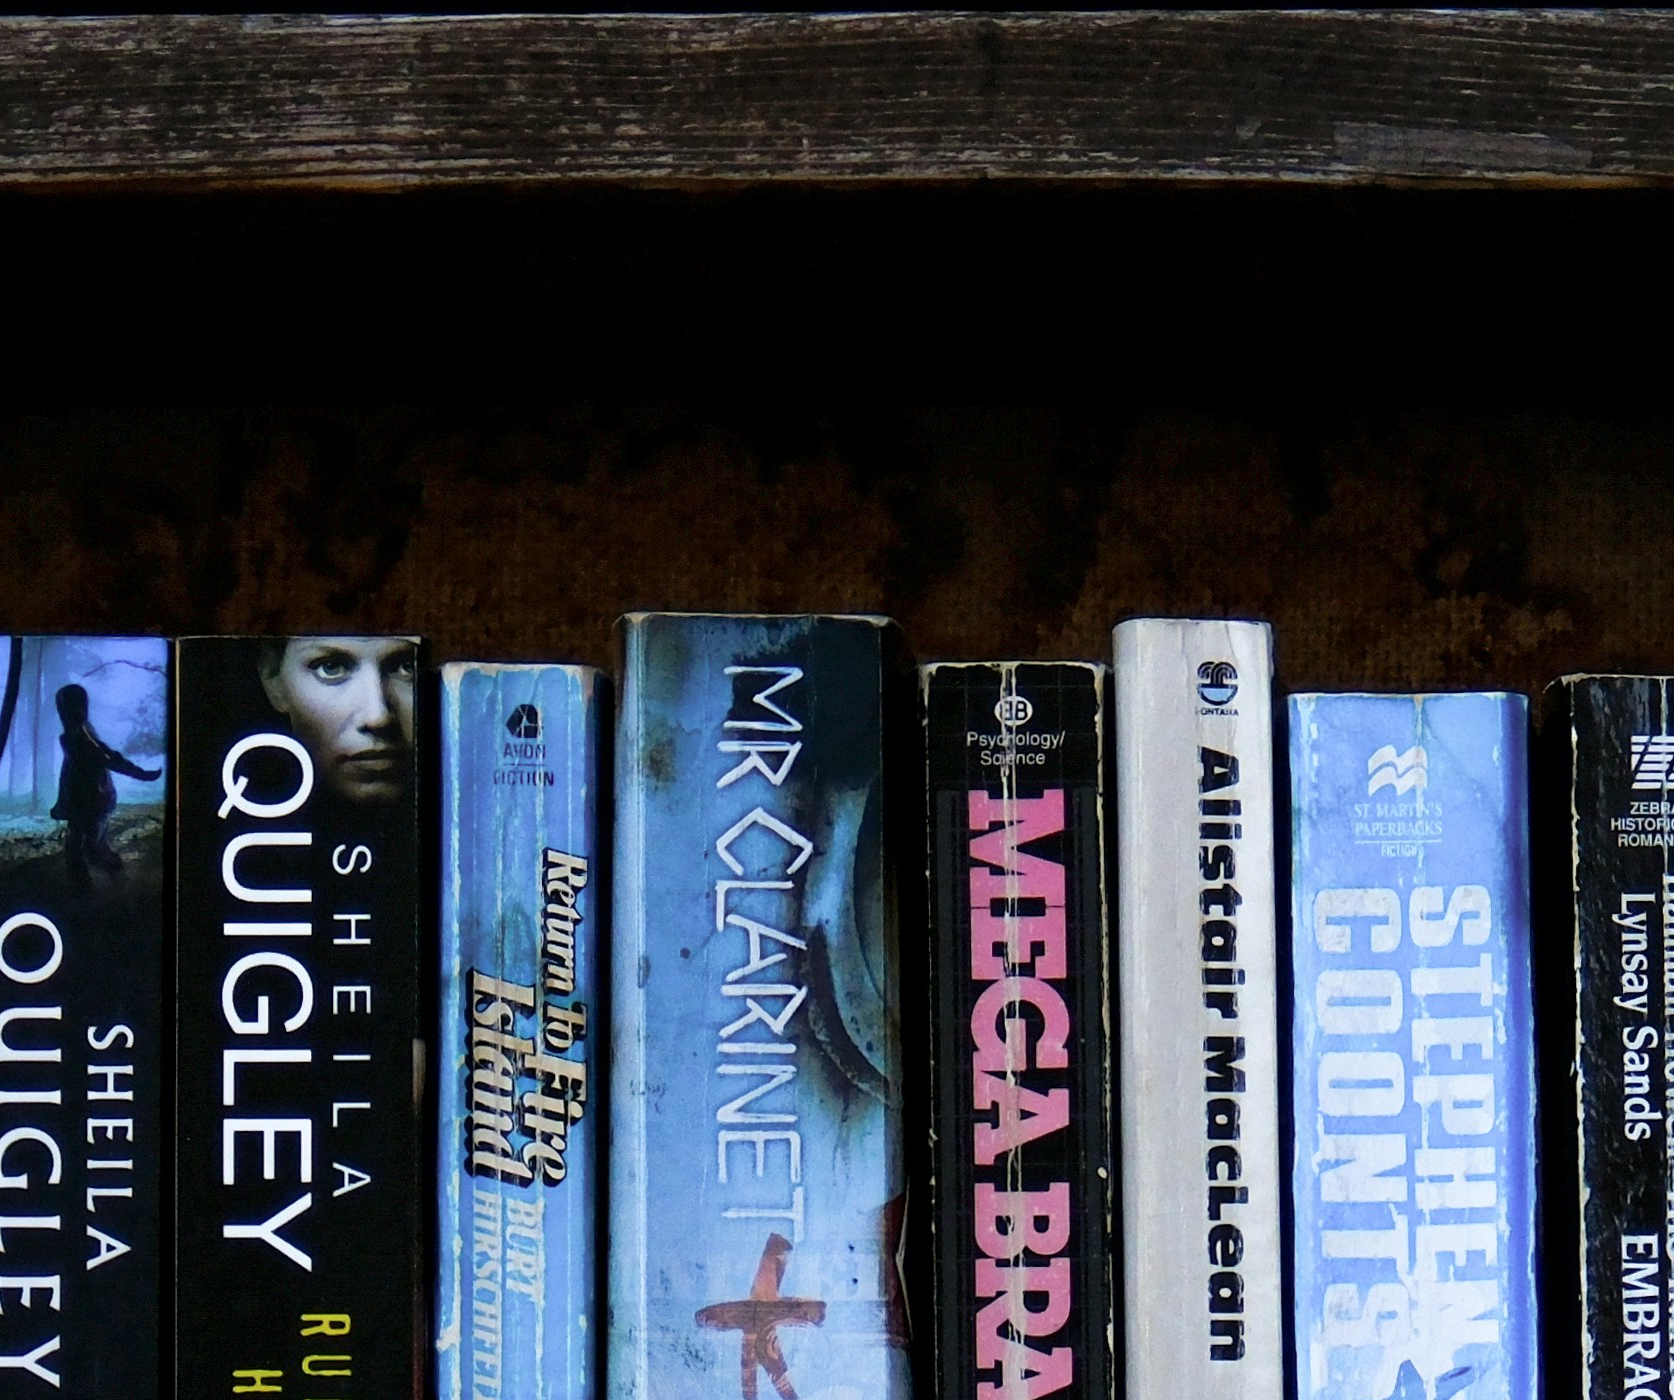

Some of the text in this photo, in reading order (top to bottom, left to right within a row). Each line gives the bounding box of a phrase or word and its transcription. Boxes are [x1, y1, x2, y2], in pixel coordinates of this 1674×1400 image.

[979, 748, 1046, 768] Science
[1353, 820, 1443, 838] PAPERBACKS
[217, 731, 315, 1273] QUIGLEY
[331, 842, 373, 1200] SHEILA
[464, 968, 537, 1190] Island
[713, 665, 815, 1244] MR CLARINET
[967, 787, 1071, 1166] MEGA
[1195, 746, 1249, 1362] Alistair MacLean
[1609, 891, 1657, 1011] Lynsay
[1621, 1025, 1658, 1142] Sands
[85, 1022, 135, 1272] SHEILA
[504, 1201, 547, 1308] BURT
[1314, 888, 1410, 1346] COONTS
[1409, 884, 1501, 1346] STEPHEN
